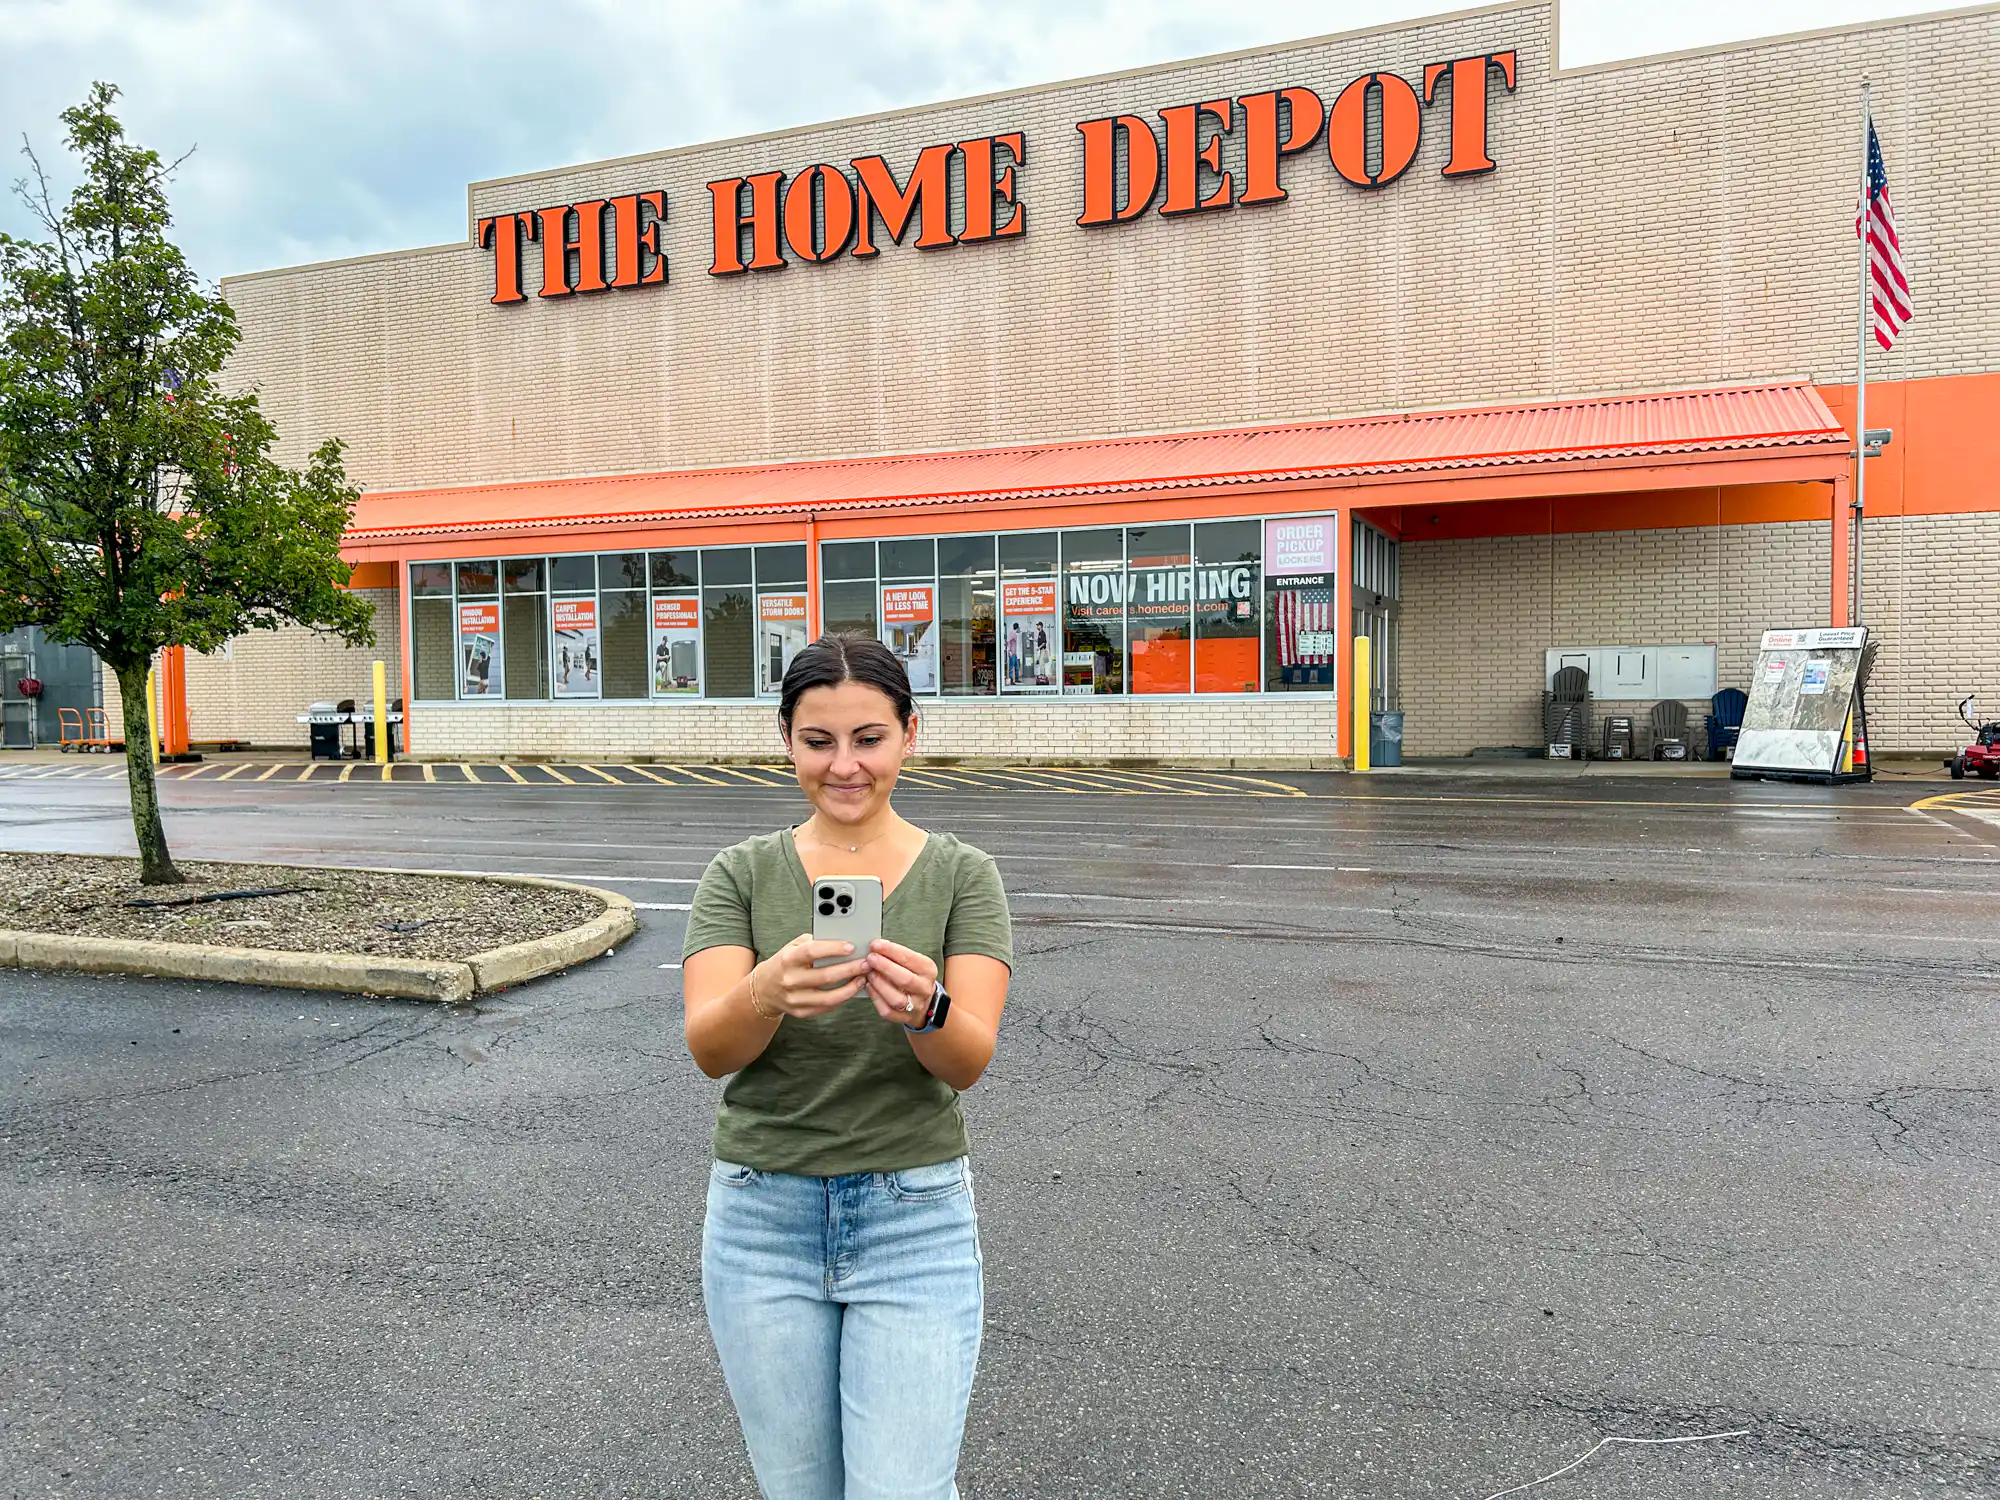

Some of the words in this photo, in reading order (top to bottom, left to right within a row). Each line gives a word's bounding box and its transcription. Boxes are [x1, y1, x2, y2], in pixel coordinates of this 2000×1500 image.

[478, 190, 668, 304] THE
[706, 131, 1026, 277] HOME
[1076, 50, 1517, 228] DEPOT
[1276, 524, 1323, 540] ORDER
[1277, 538, 1323, 553] PICKUP
[1278, 554, 1322, 565] LOCKERS
[1070, 573, 1137, 605] NOW
[1147, 567, 1251, 602] HIRING
[1276, 576, 1325, 586] ENTRANCE
[886, 592, 891, 602] A
[892, 591, 908, 601] NEW
[909, 590, 927, 601] LOOK
[1005, 587, 1017, 597] GET
[1018, 586, 1030, 596] THE
[762, 598, 793, 607] VERSATILE
[886, 601, 894, 611] IN
[895, 600, 912, 611] LESS
[912, 600, 929, 610] TIME
[1005, 595, 1044, 606] EXPERIENCE
[555, 604, 577, 613] CARPET
[762, 607, 783, 617] STORM
[784, 606, 805, 617] DOORS
[1071, 605, 1093, 616] Visit
[555, 611, 594, 622] INSTALLATION
[656, 611, 697, 620] PROFESSIONALS
